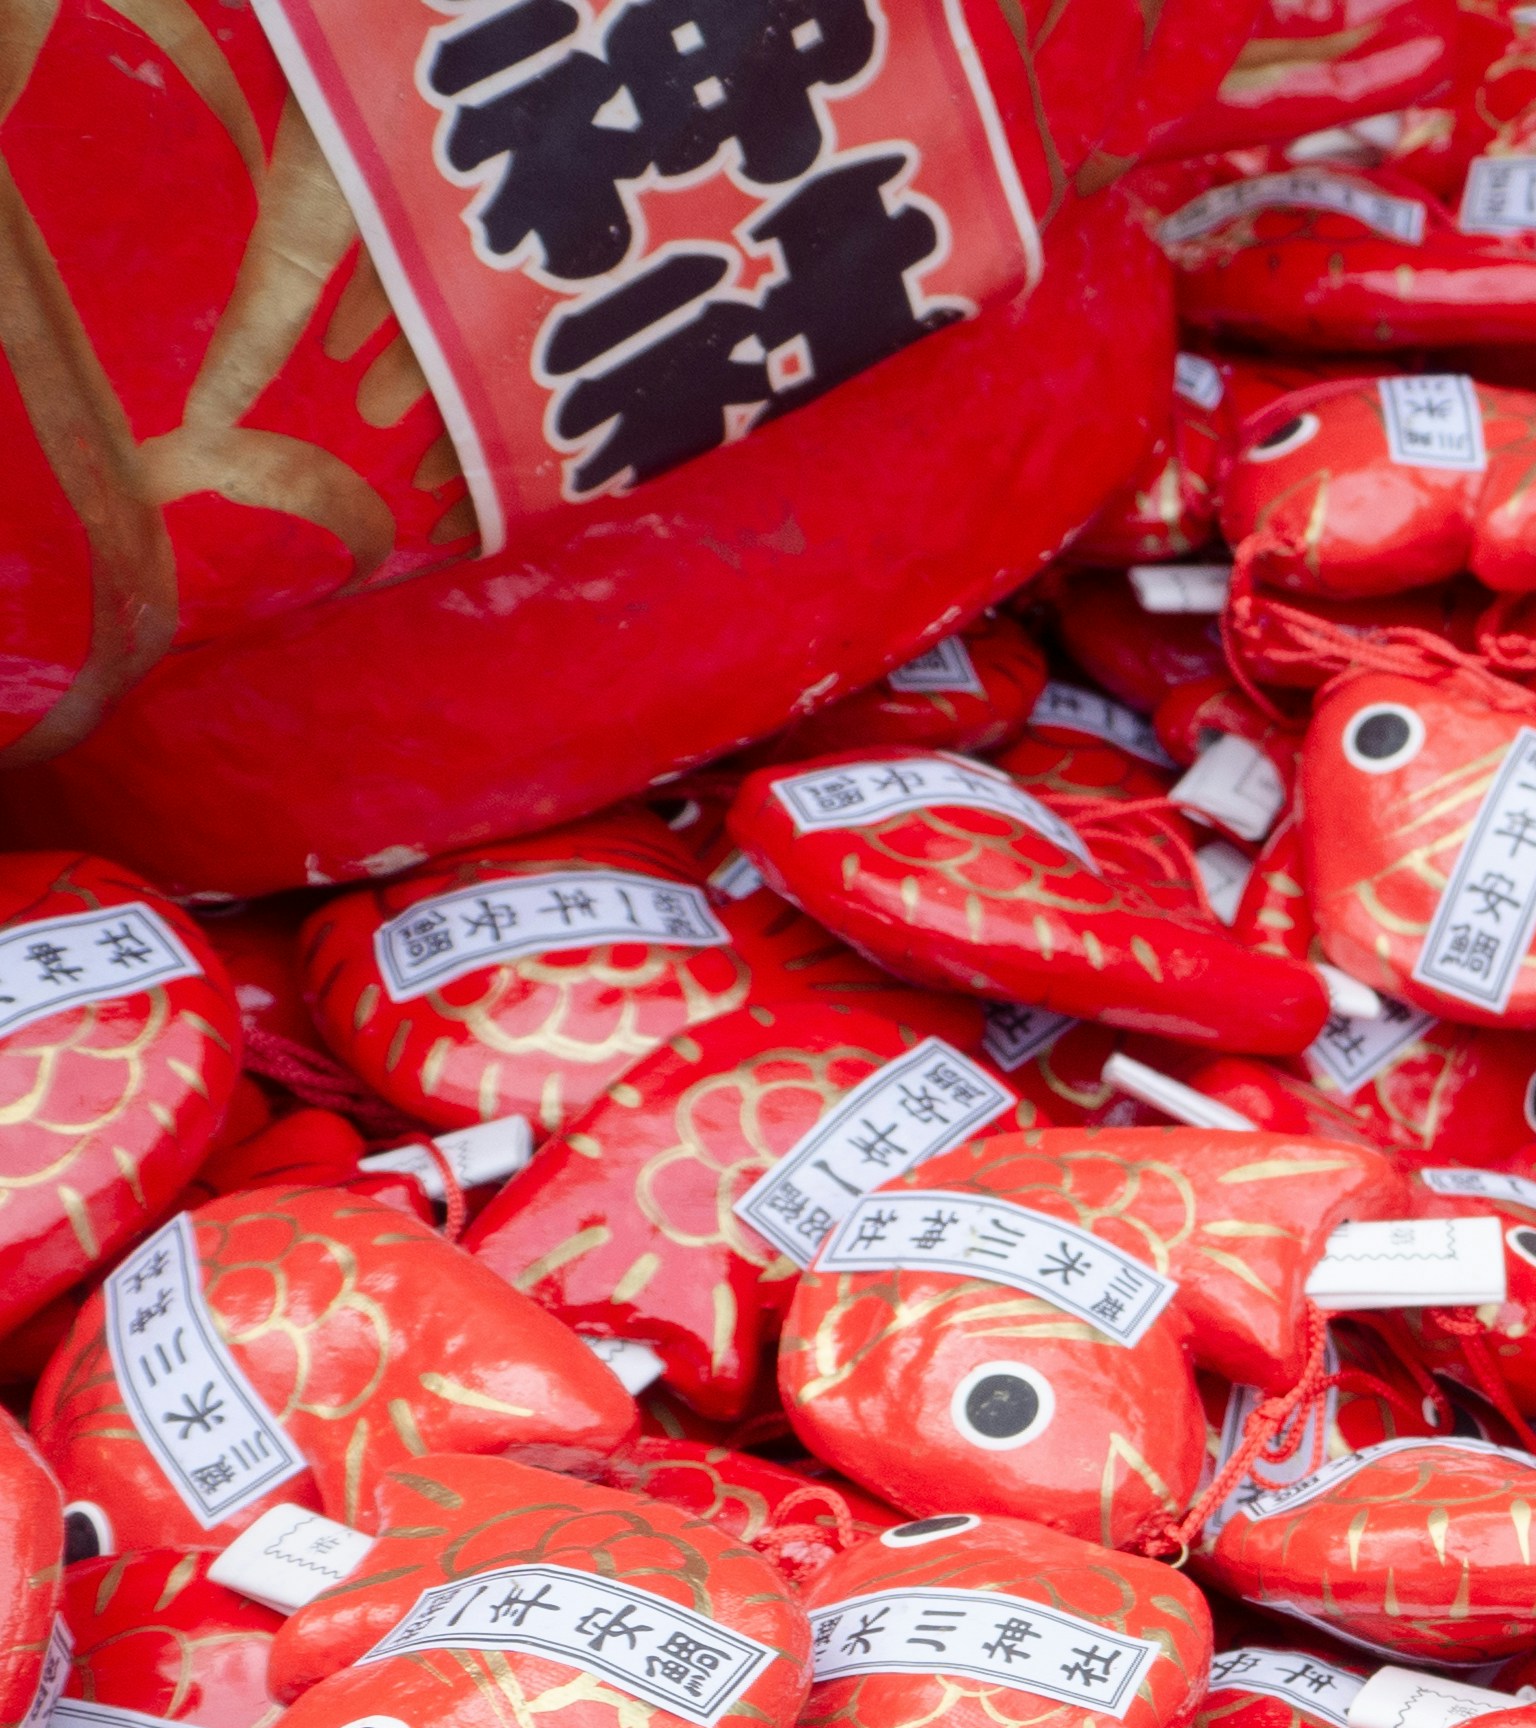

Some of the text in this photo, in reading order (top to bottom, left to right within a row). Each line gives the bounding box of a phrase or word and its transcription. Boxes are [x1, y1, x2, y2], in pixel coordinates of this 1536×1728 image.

[400, 887, 641, 967] 一年安鯛
[811, 1060, 988, 1197] 一年安鯛
[847, 1208, 1095, 1290] 氷川神社
[1089, 1266, 1149, 1324] 川越
[125, 1248, 227, 1441] 氷川神社
[189, 1430, 272, 1496] 川越
[446, 1583, 733, 1699] 一年安鯛
[840, 1605, 1122, 1688] 氷川神社
